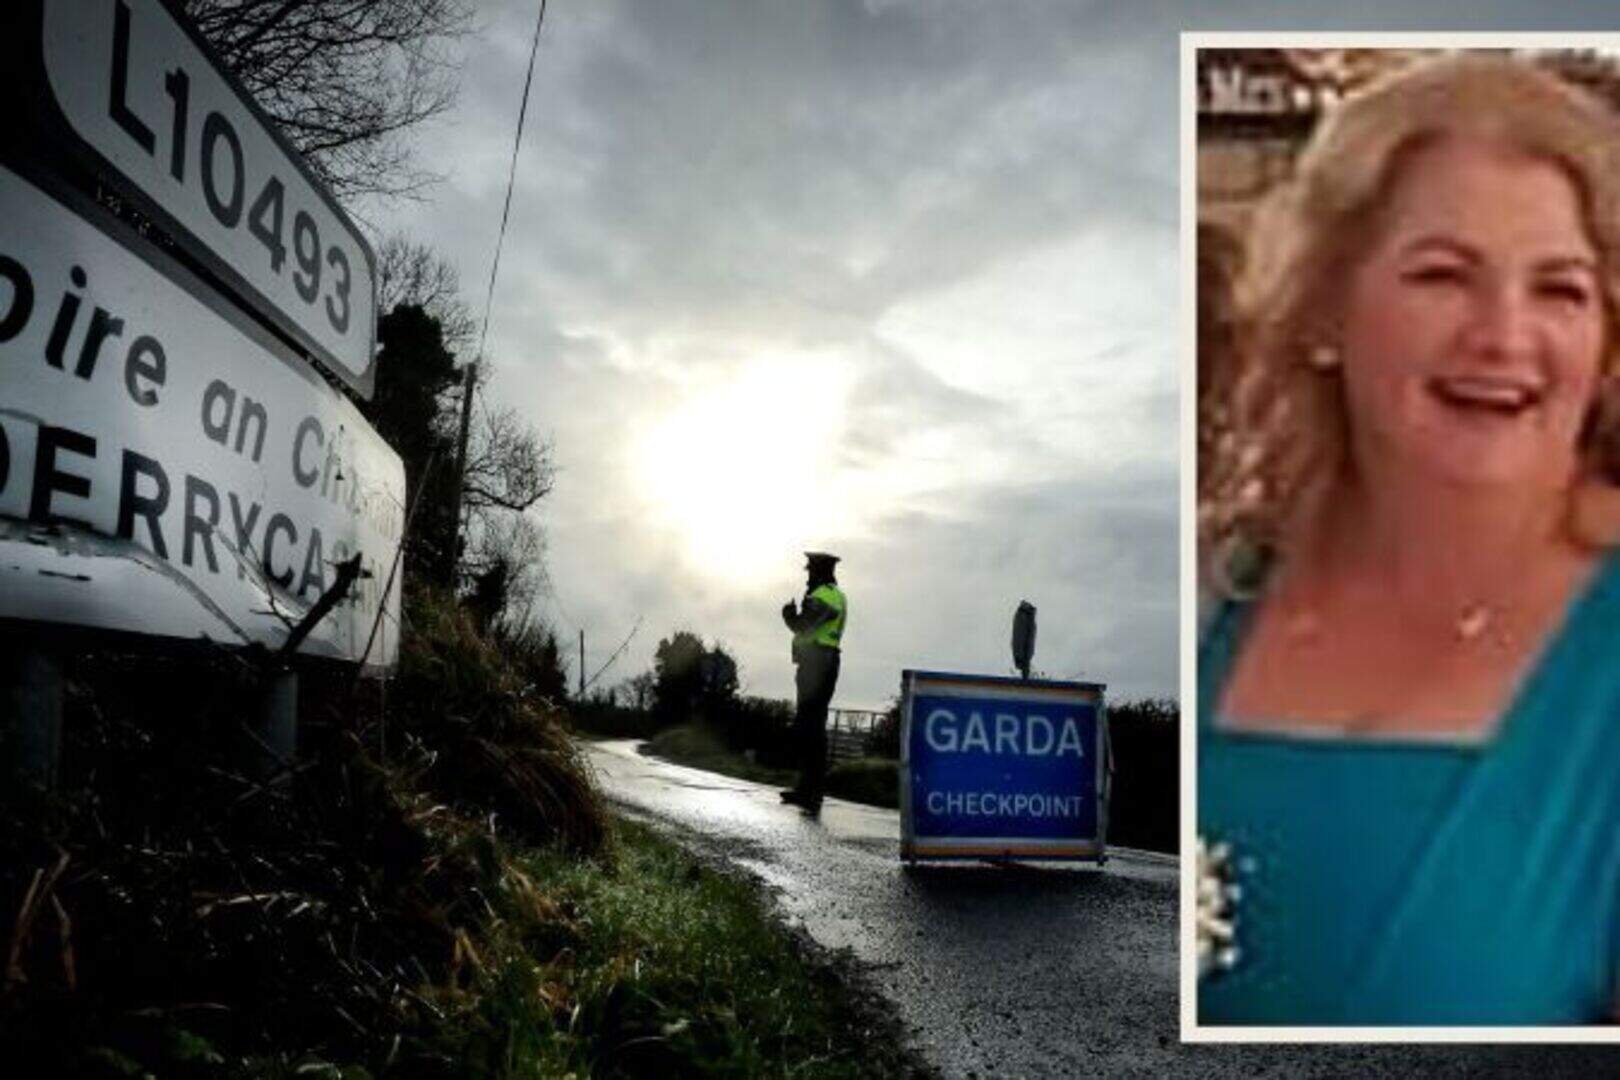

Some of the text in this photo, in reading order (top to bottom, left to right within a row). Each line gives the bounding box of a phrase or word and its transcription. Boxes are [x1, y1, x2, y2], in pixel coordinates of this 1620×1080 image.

[109, 0, 351, 335] L10493
[201, 378, 268, 464] an
[925, 709, 1084, 757] GARDA
[927, 792, 1083, 817] CHECKPOINT
